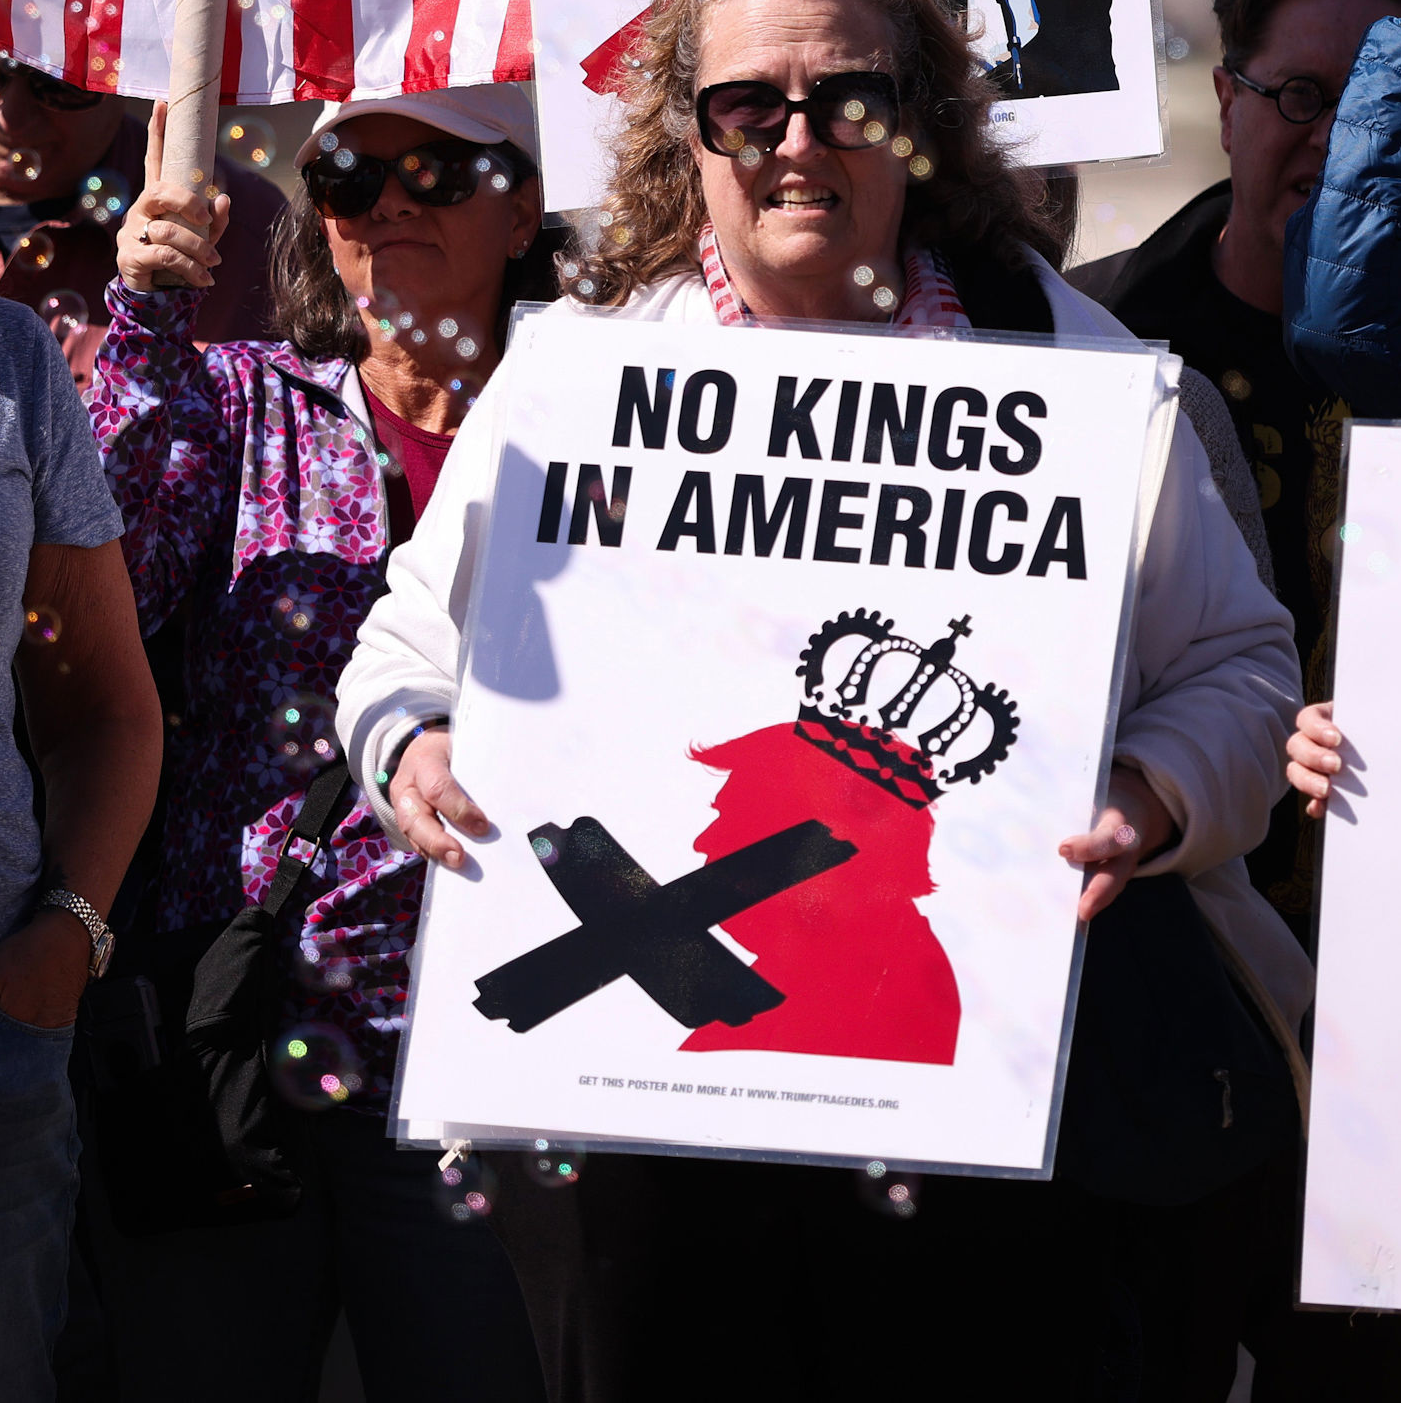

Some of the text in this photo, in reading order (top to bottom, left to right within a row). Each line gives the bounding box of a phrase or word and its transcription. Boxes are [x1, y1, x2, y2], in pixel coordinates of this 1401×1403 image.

[611, 365, 1048, 476] NO KINGS
[536, 462, 1087, 581] IN AMERICA
[578, 1074, 900, 1111] GET THIS POSTER AND MORE AT WWW.TRUMPTRAGEDIES.ORG
